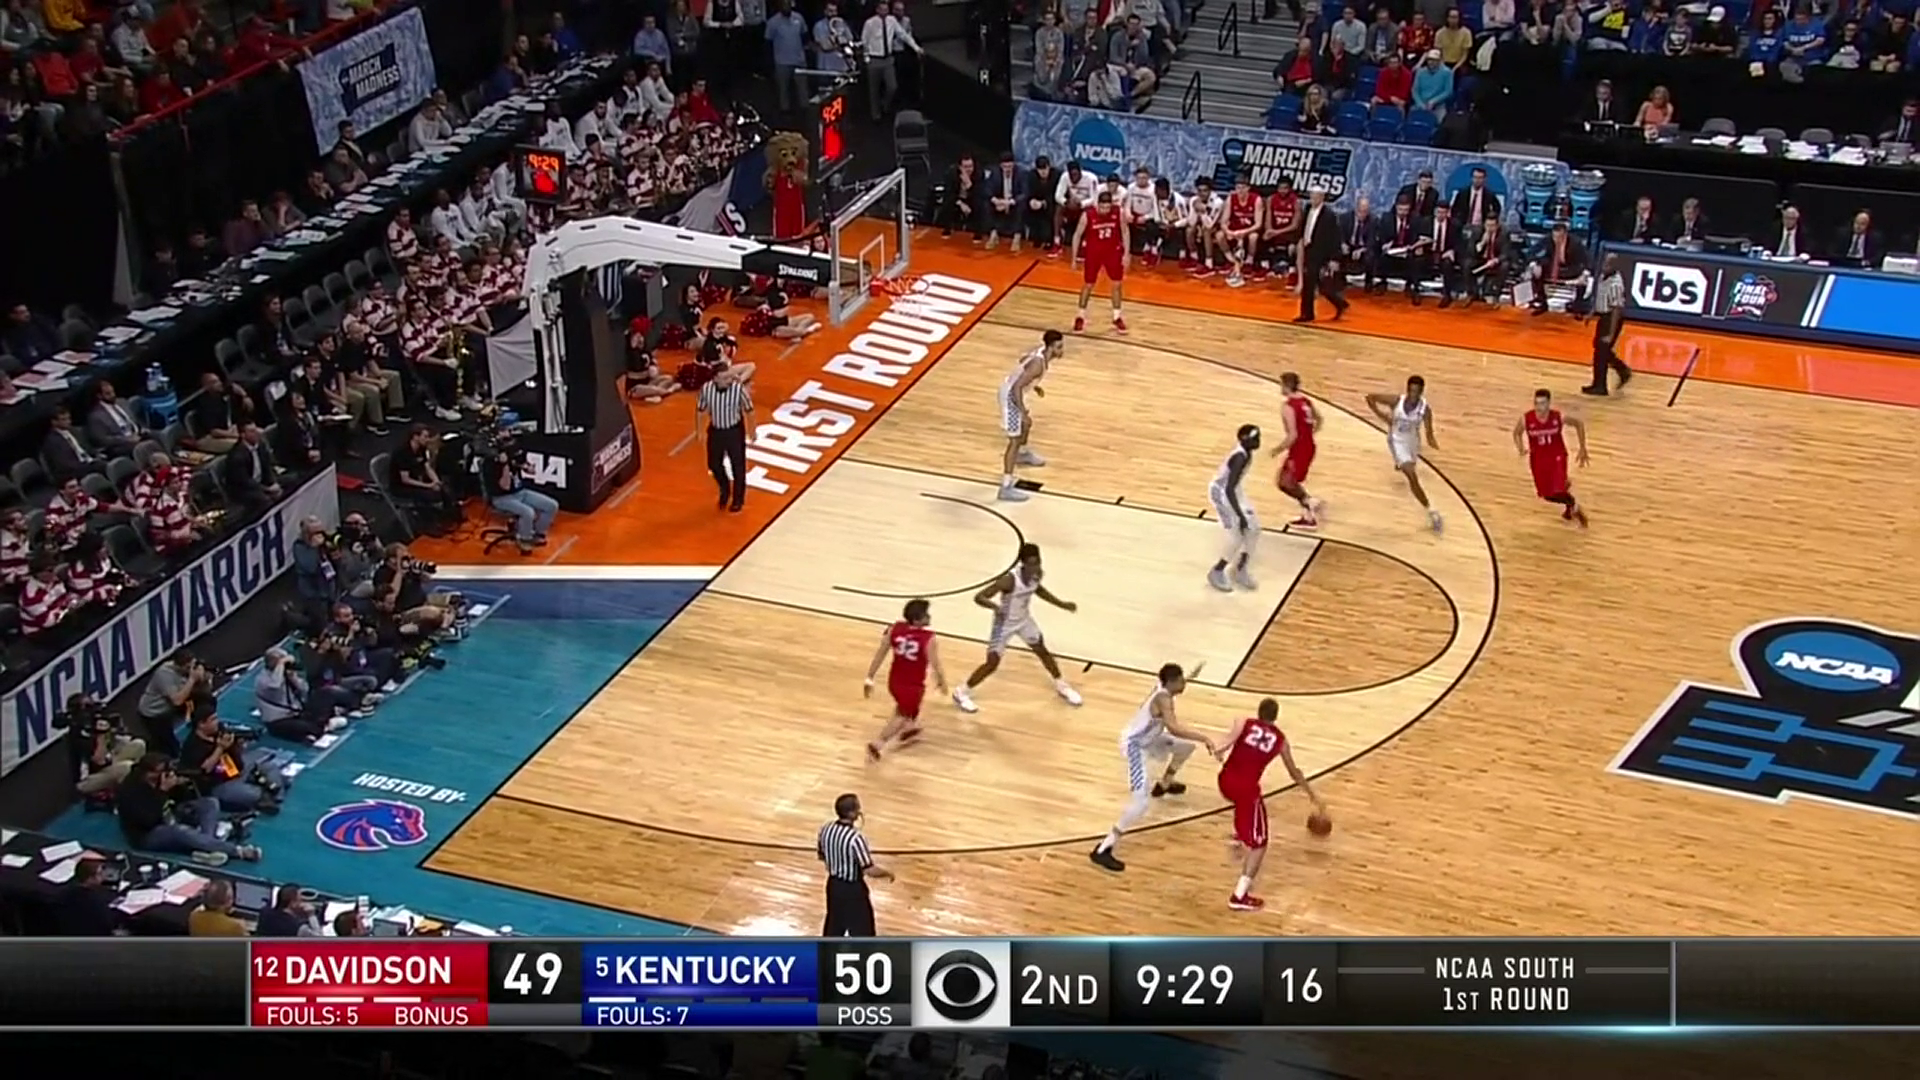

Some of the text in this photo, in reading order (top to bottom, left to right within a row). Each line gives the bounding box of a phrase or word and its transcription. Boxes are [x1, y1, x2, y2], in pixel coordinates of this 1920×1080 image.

[348, 55, 382, 84] MARCH
[355, 65, 400, 99] MADNESS
[528, 153, 560, 171] 9:29
[1074, 143, 1123, 163] NCAA
[1243, 143, 1314, 171] MARCH
[778, 263, 818, 281] SPALDING
[1638, 268, 1699, 305] tbs
[1734, 281, 1767, 296] FINAL
[1734, 293, 1766, 305] FOUR
[821, 273, 993, 388] ROUND
[148, 510, 287, 662] MARCH
[894, 636, 921, 661] 32
[1774, 651, 1894, 685] NCAA
[1245, 724, 1278, 753] 23
[352, 772, 436, 798] HOSTED
